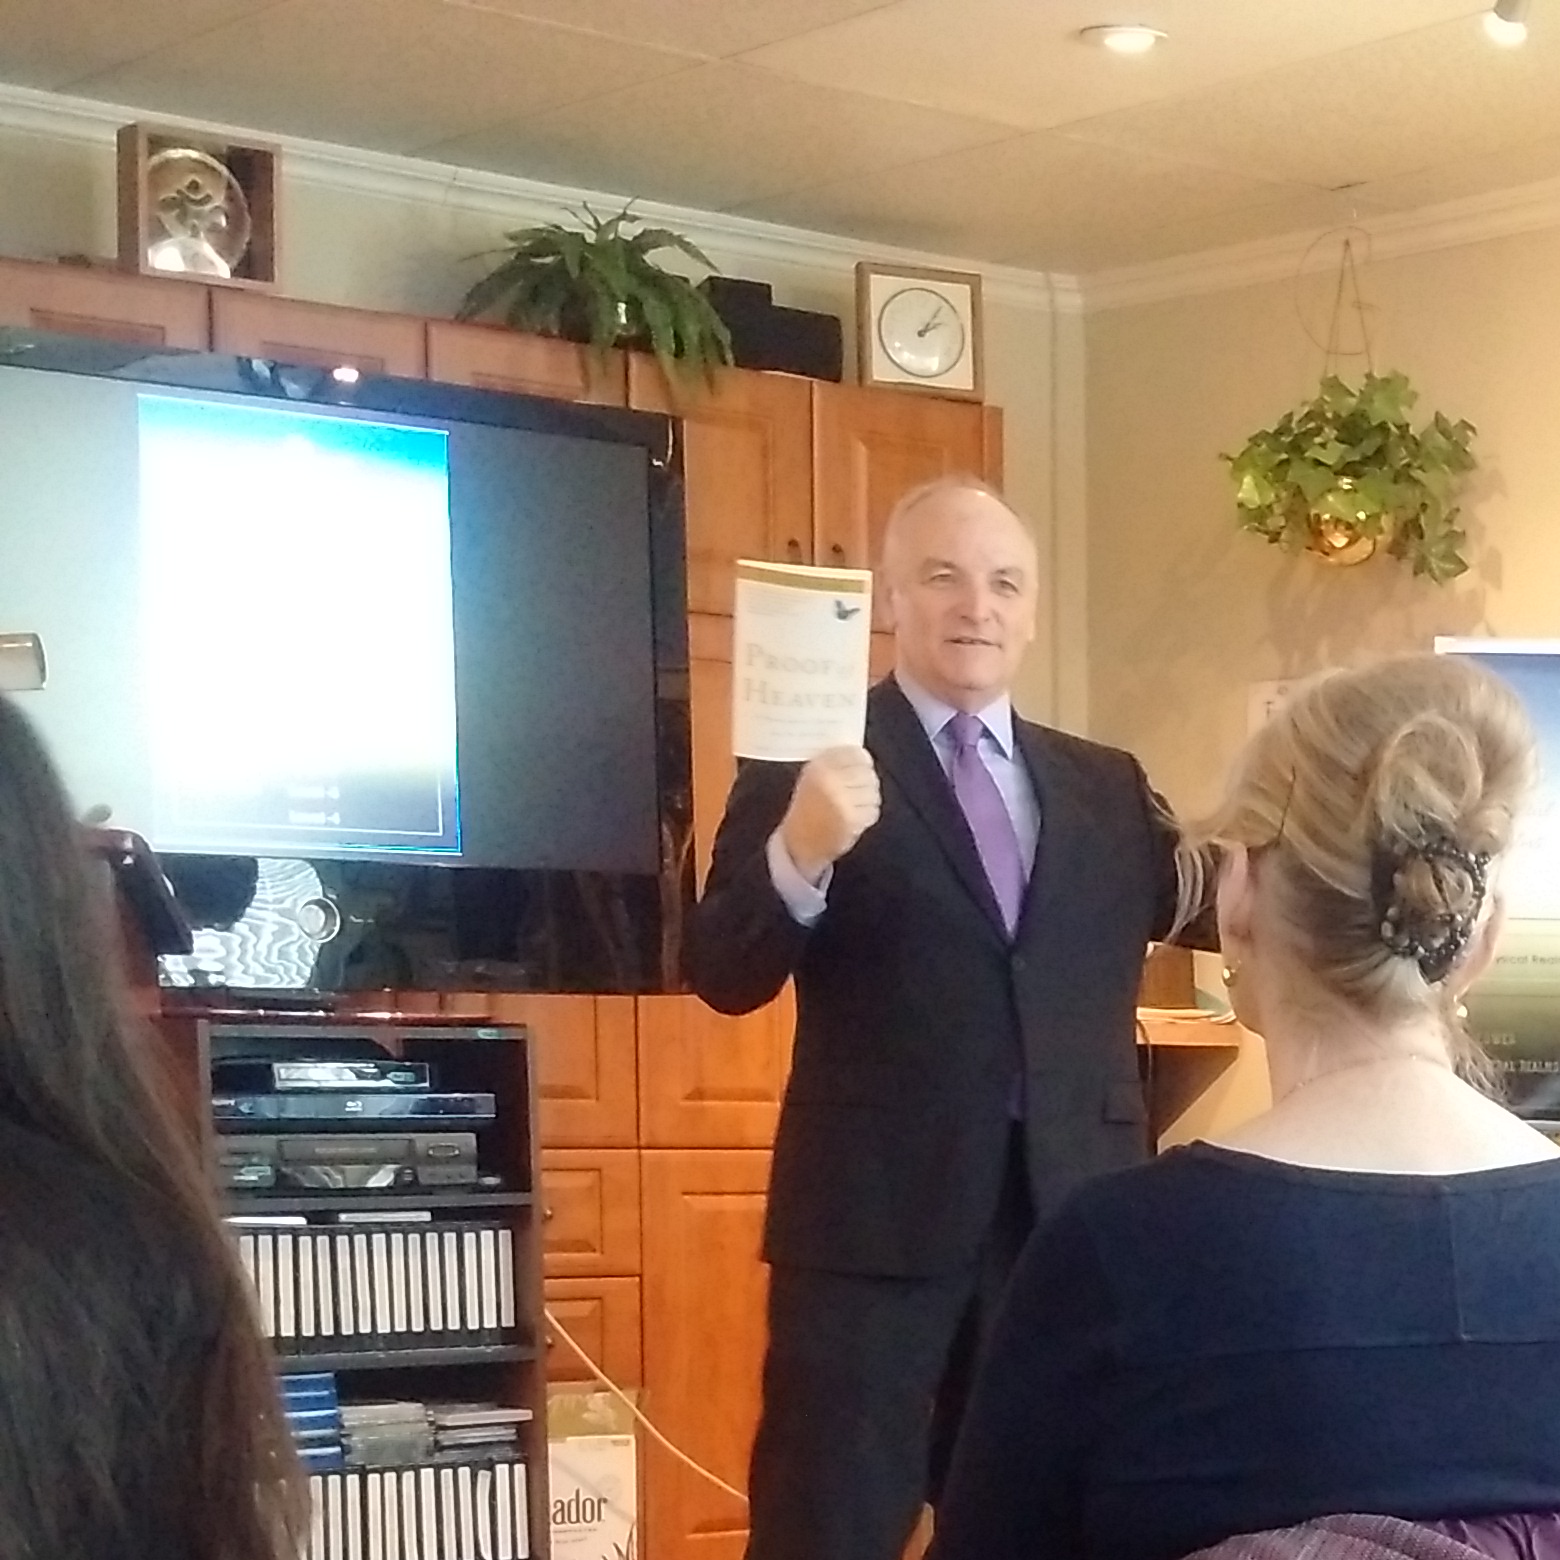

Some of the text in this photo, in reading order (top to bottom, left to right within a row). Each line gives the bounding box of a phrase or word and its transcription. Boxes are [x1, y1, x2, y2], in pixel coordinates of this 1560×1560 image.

[1496, 955, 1528, 965] ysical
[1520, 1060, 1559, 1073] REALMS
[552, 1487, 608, 1526] ador
